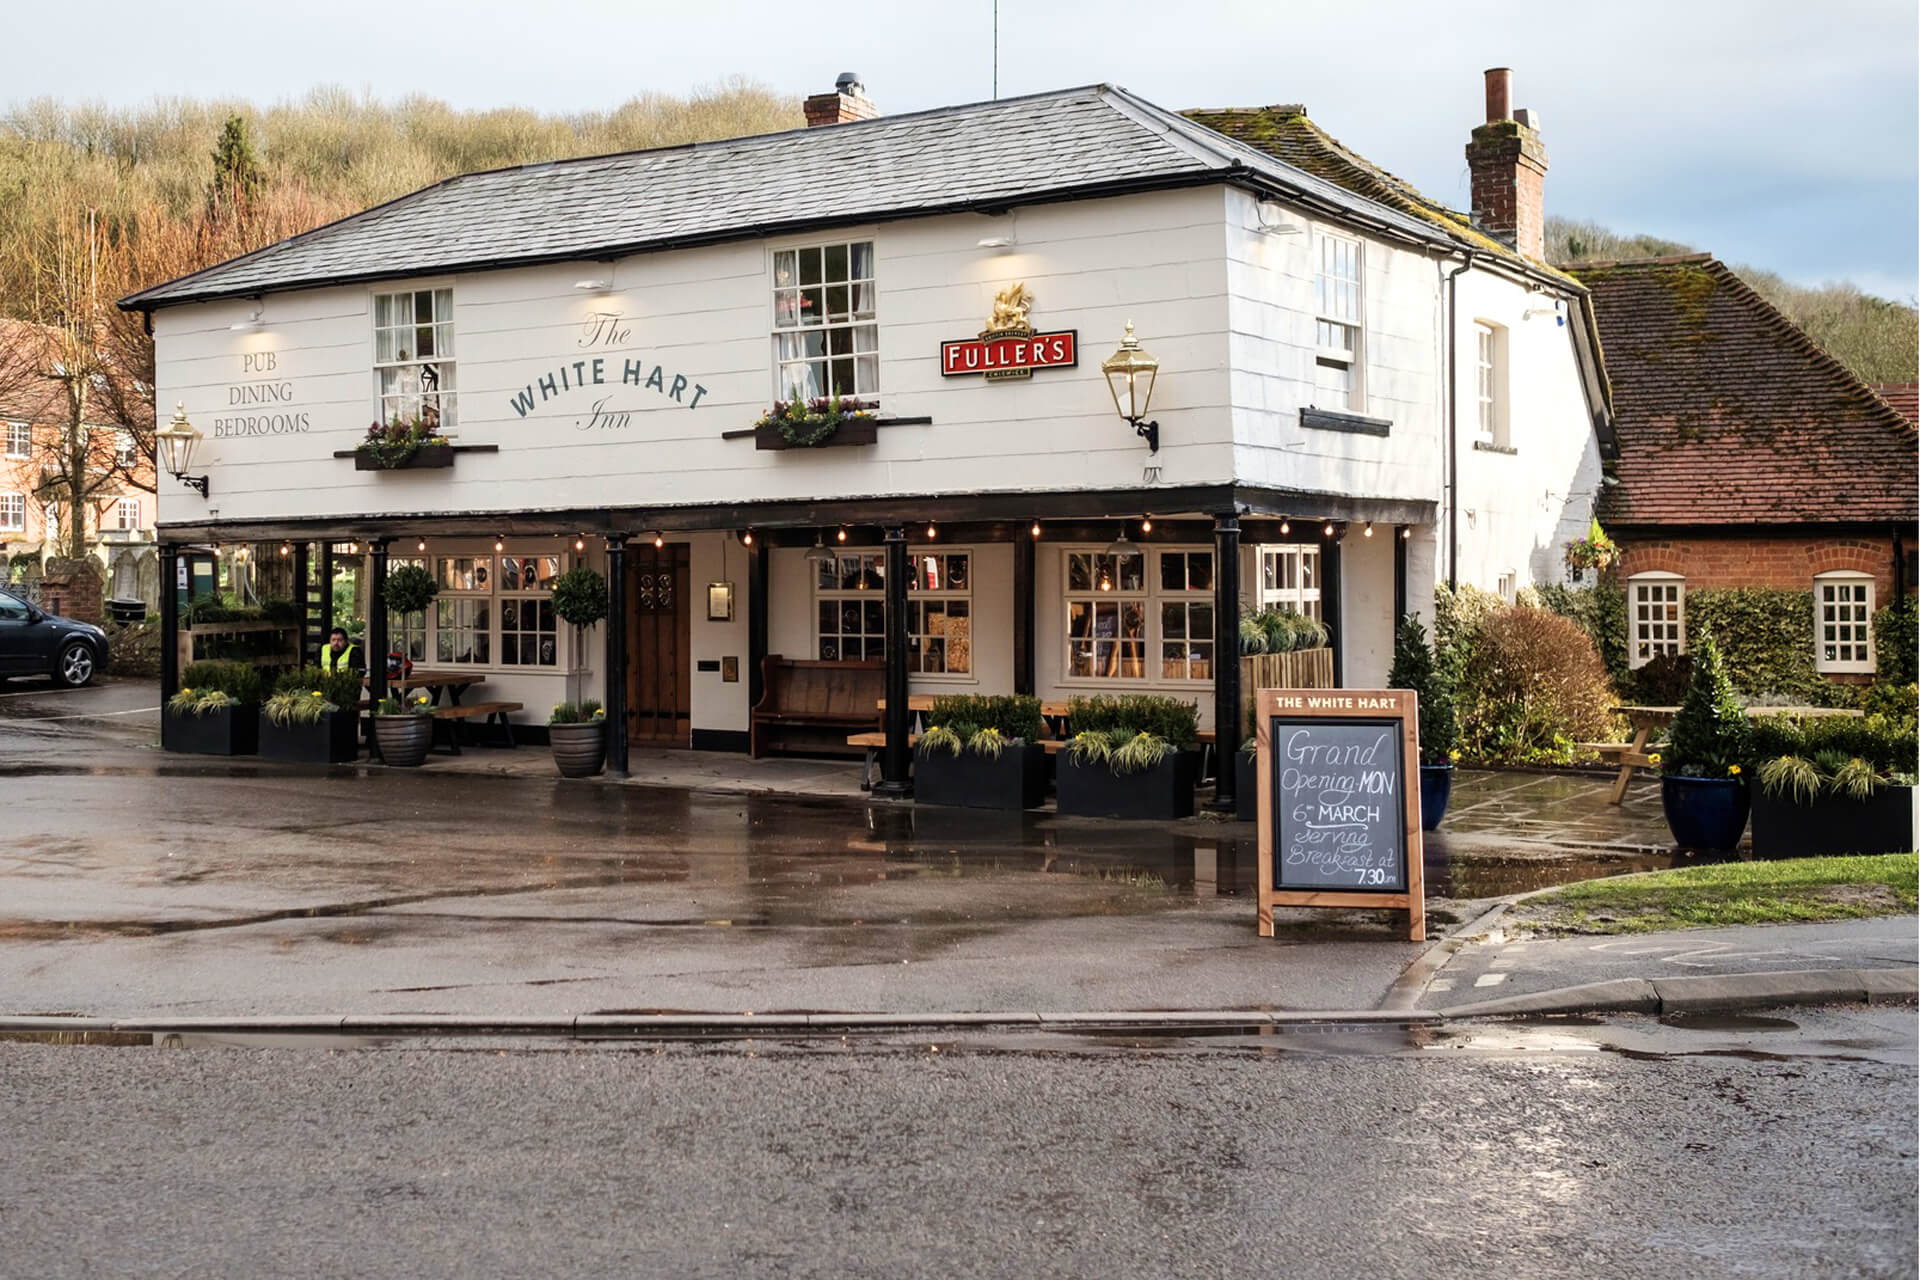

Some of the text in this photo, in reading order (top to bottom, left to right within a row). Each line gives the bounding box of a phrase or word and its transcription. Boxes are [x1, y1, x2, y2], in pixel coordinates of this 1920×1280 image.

[578, 311, 632, 349] The
[243, 351, 277, 373] PUB
[948, 336, 1065, 370] FULLER'S
[228, 381, 293, 405] DINING
[510, 358, 708, 418] WHITE HART
[214, 412, 310, 437] BEDROOMS
[576, 394, 632, 431] Inn
[1276, 696, 1397, 710] THE WHITE HART
[1287, 729, 1389, 766] Grand
[1318, 804, 1380, 823] MARCH
[1378, 847, 1395, 868] at
